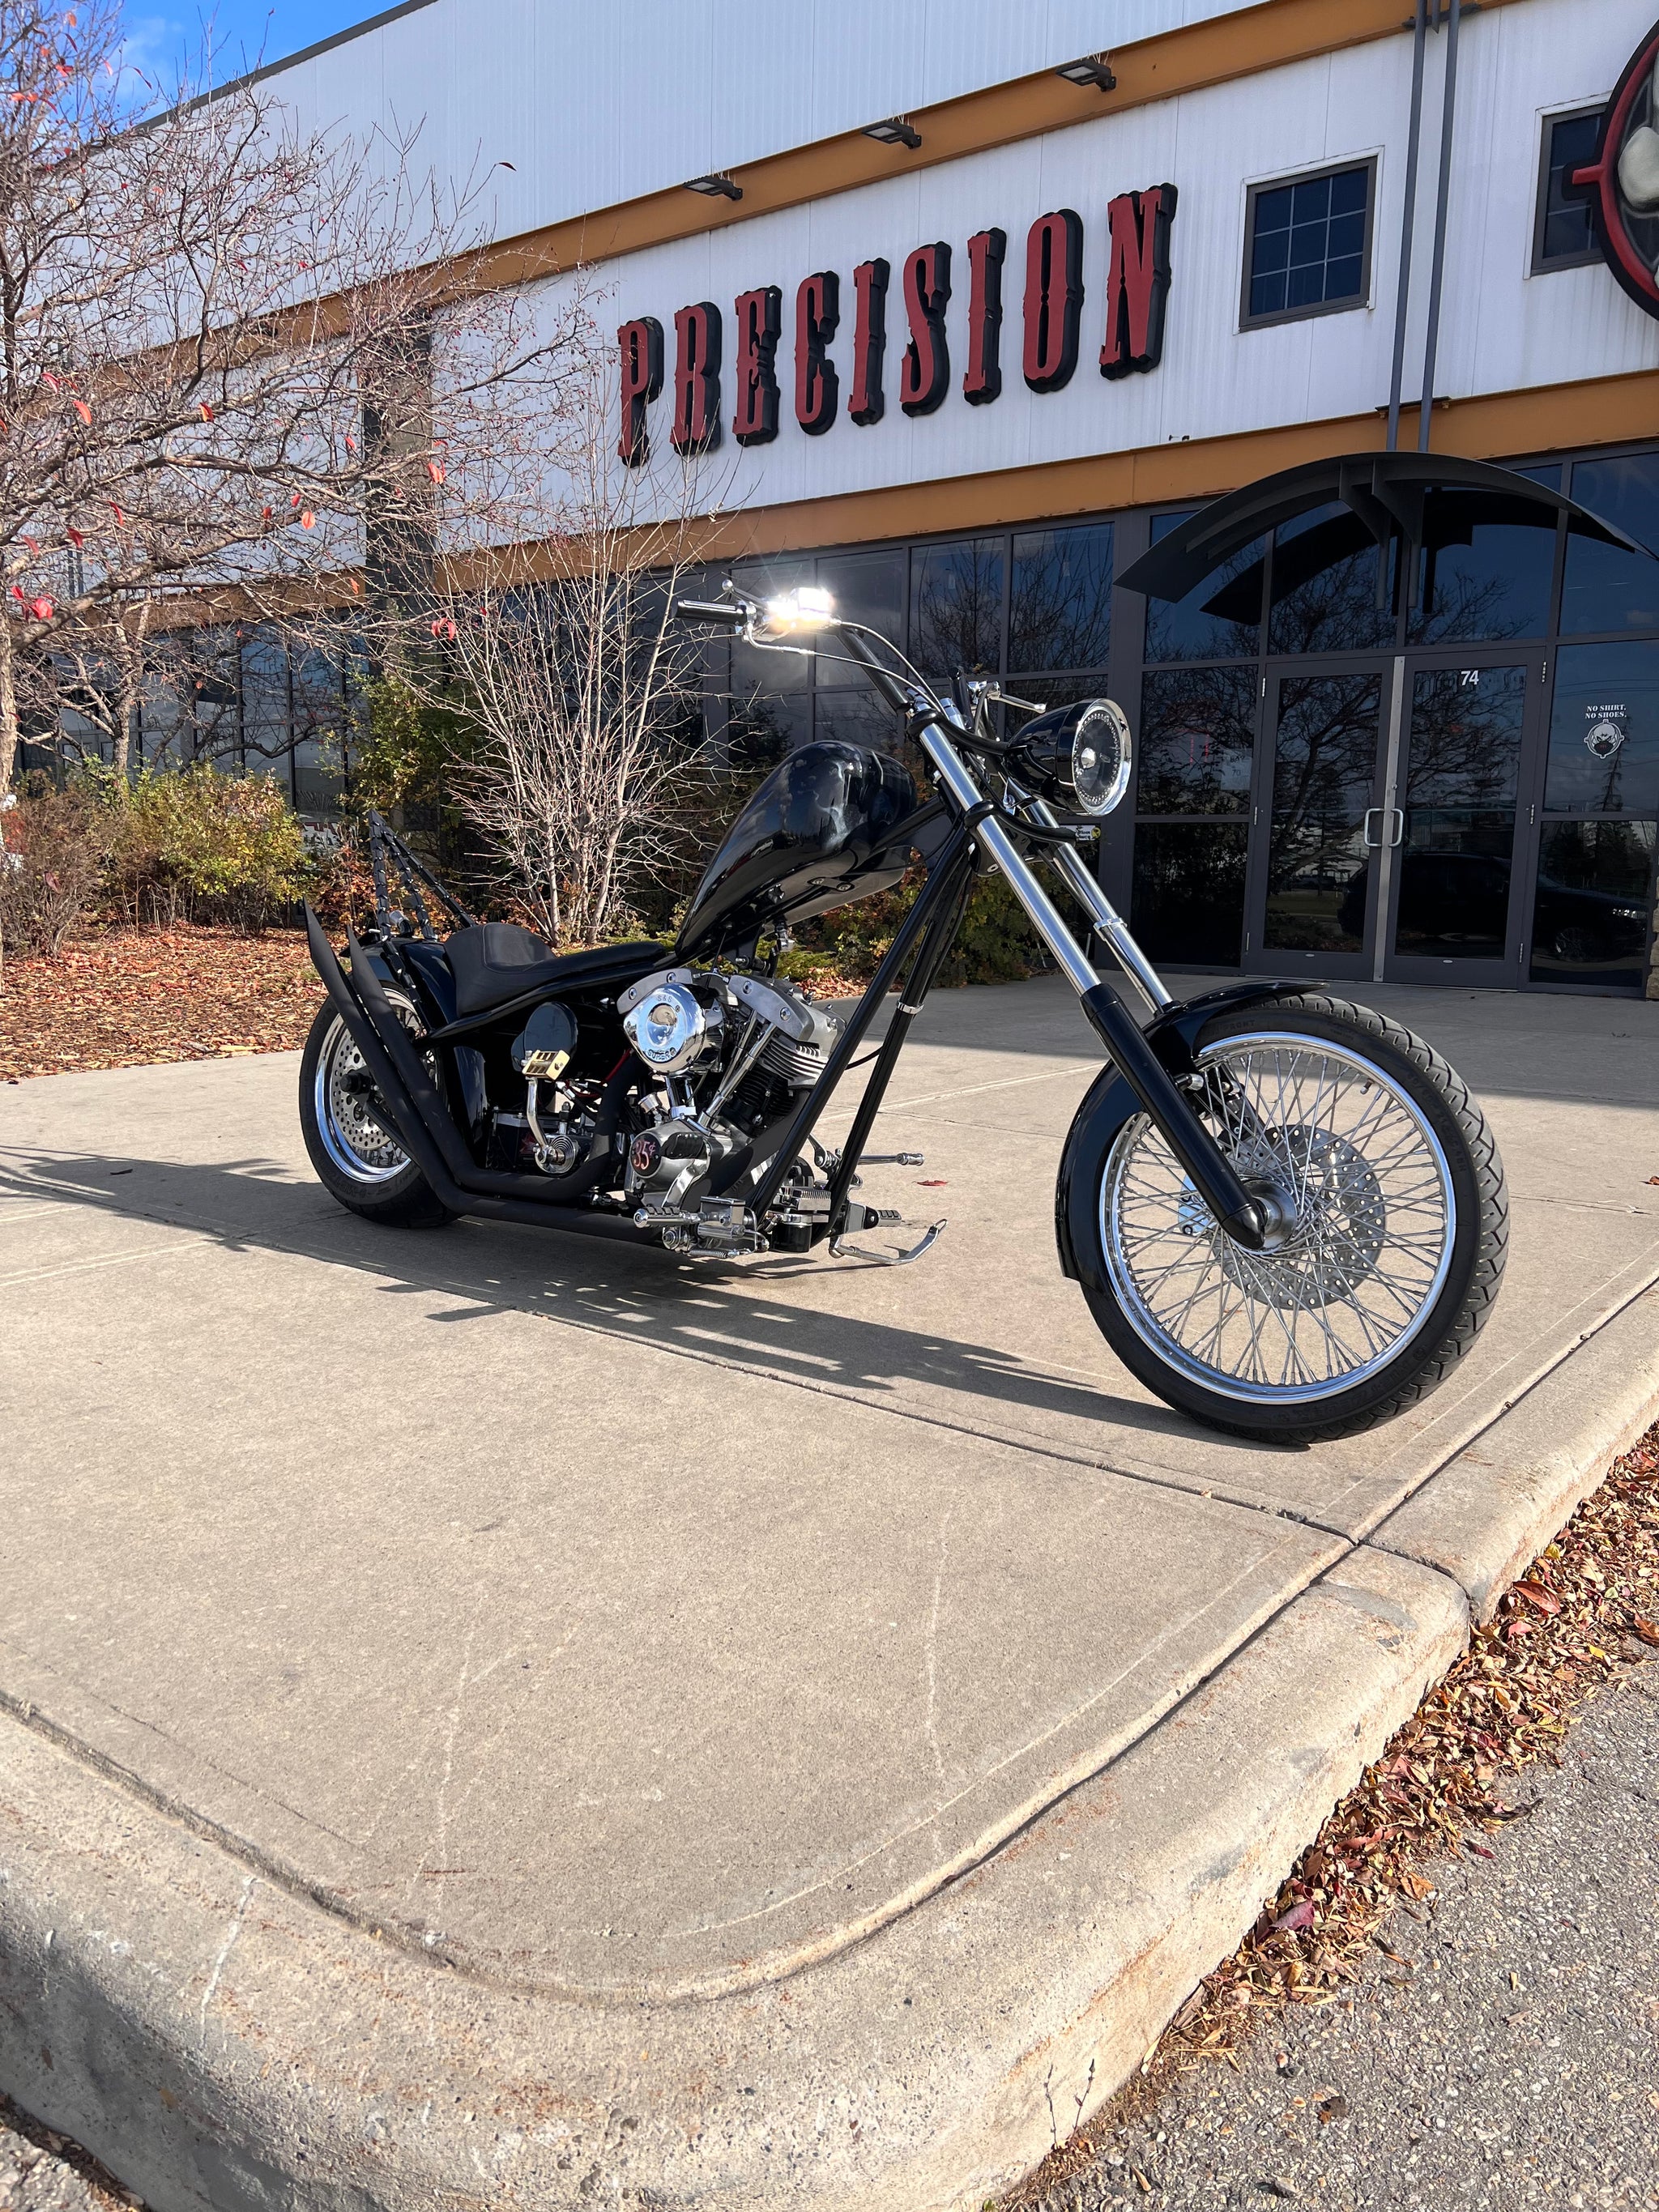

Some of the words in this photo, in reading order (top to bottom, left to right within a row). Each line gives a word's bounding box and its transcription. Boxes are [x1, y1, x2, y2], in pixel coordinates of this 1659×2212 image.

[617, 182, 1178, 467] PRECISION
[1461, 670, 1479, 686] 74
[633, 1140, 656, 1170] 35¢
